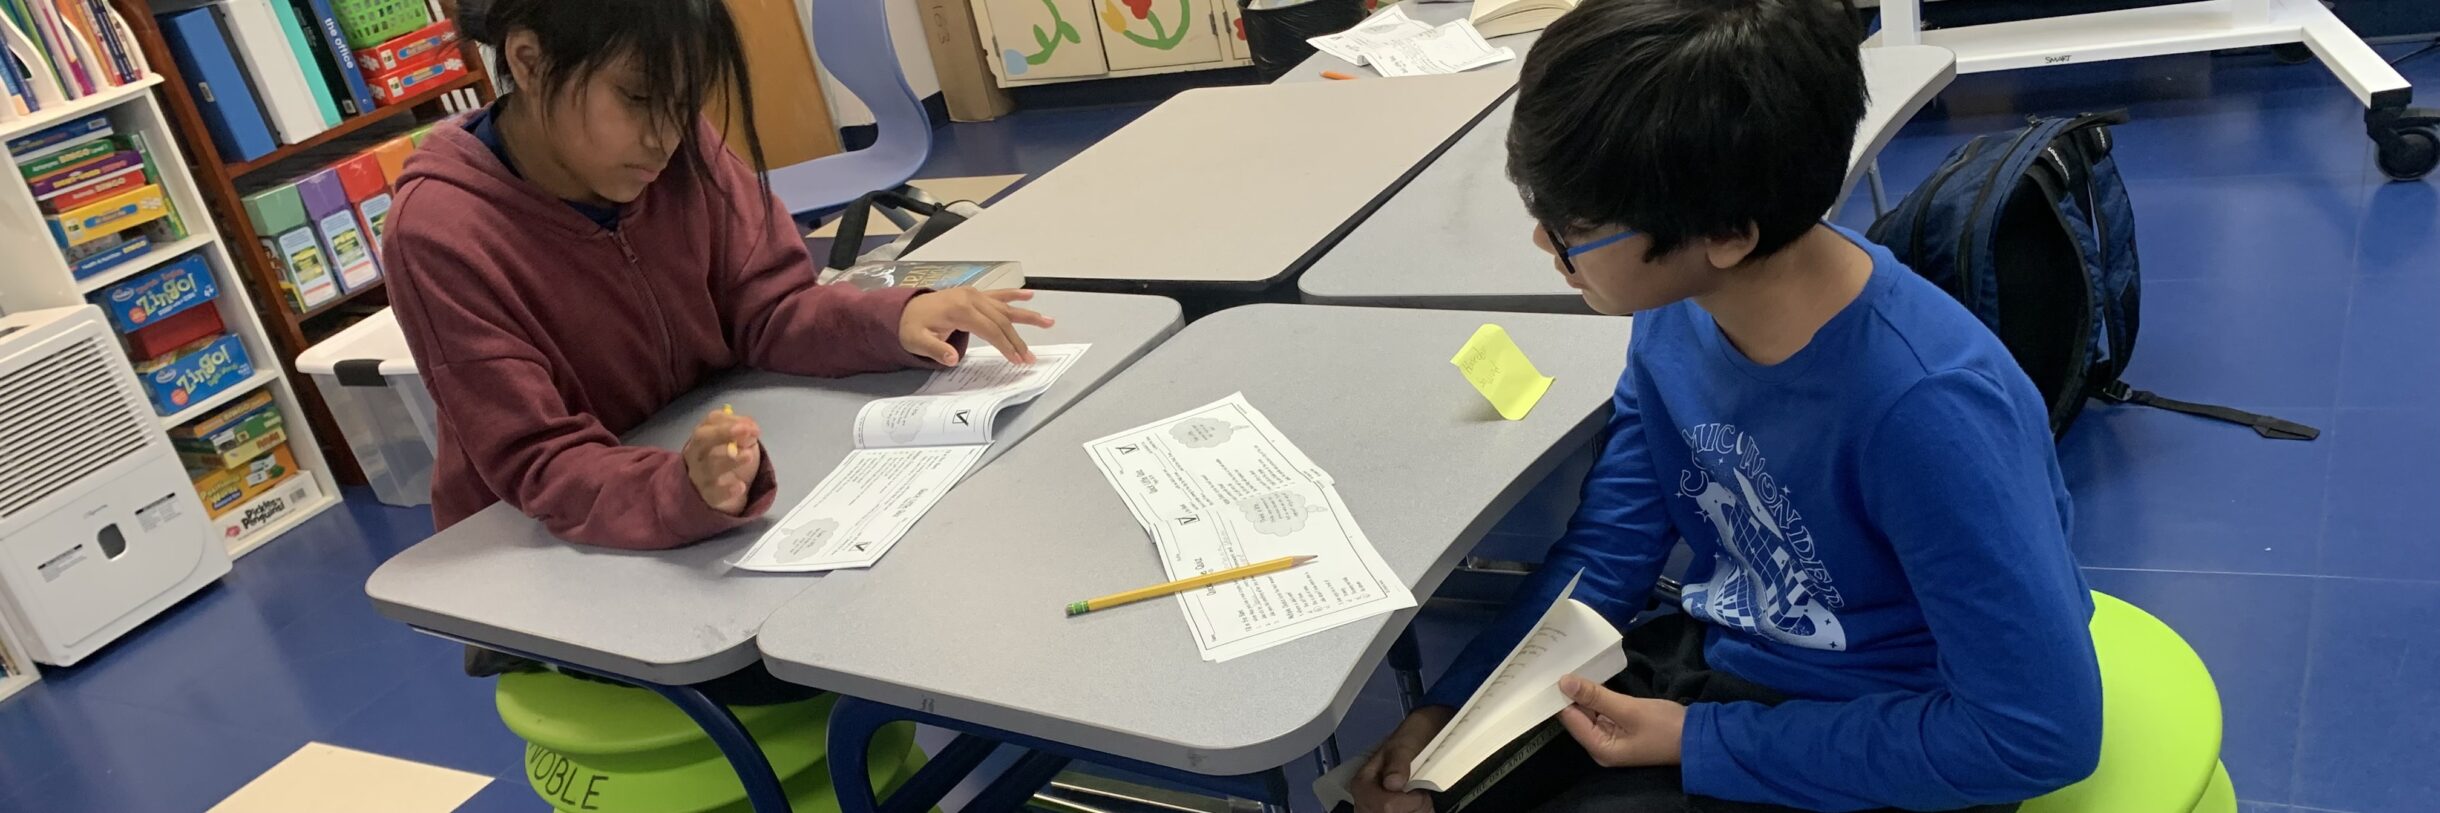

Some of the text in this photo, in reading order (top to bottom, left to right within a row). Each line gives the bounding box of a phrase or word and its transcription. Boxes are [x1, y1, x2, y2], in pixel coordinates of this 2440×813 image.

[324, 17, 354, 69] the office
[2044, 54, 2072, 64] SMART
[136, 272, 198, 317] Zingo!
[176, 343, 232, 395] Zingo!
[241, 502, 285, 530] Penguins!
[528, 743, 610, 811] NOBLE
